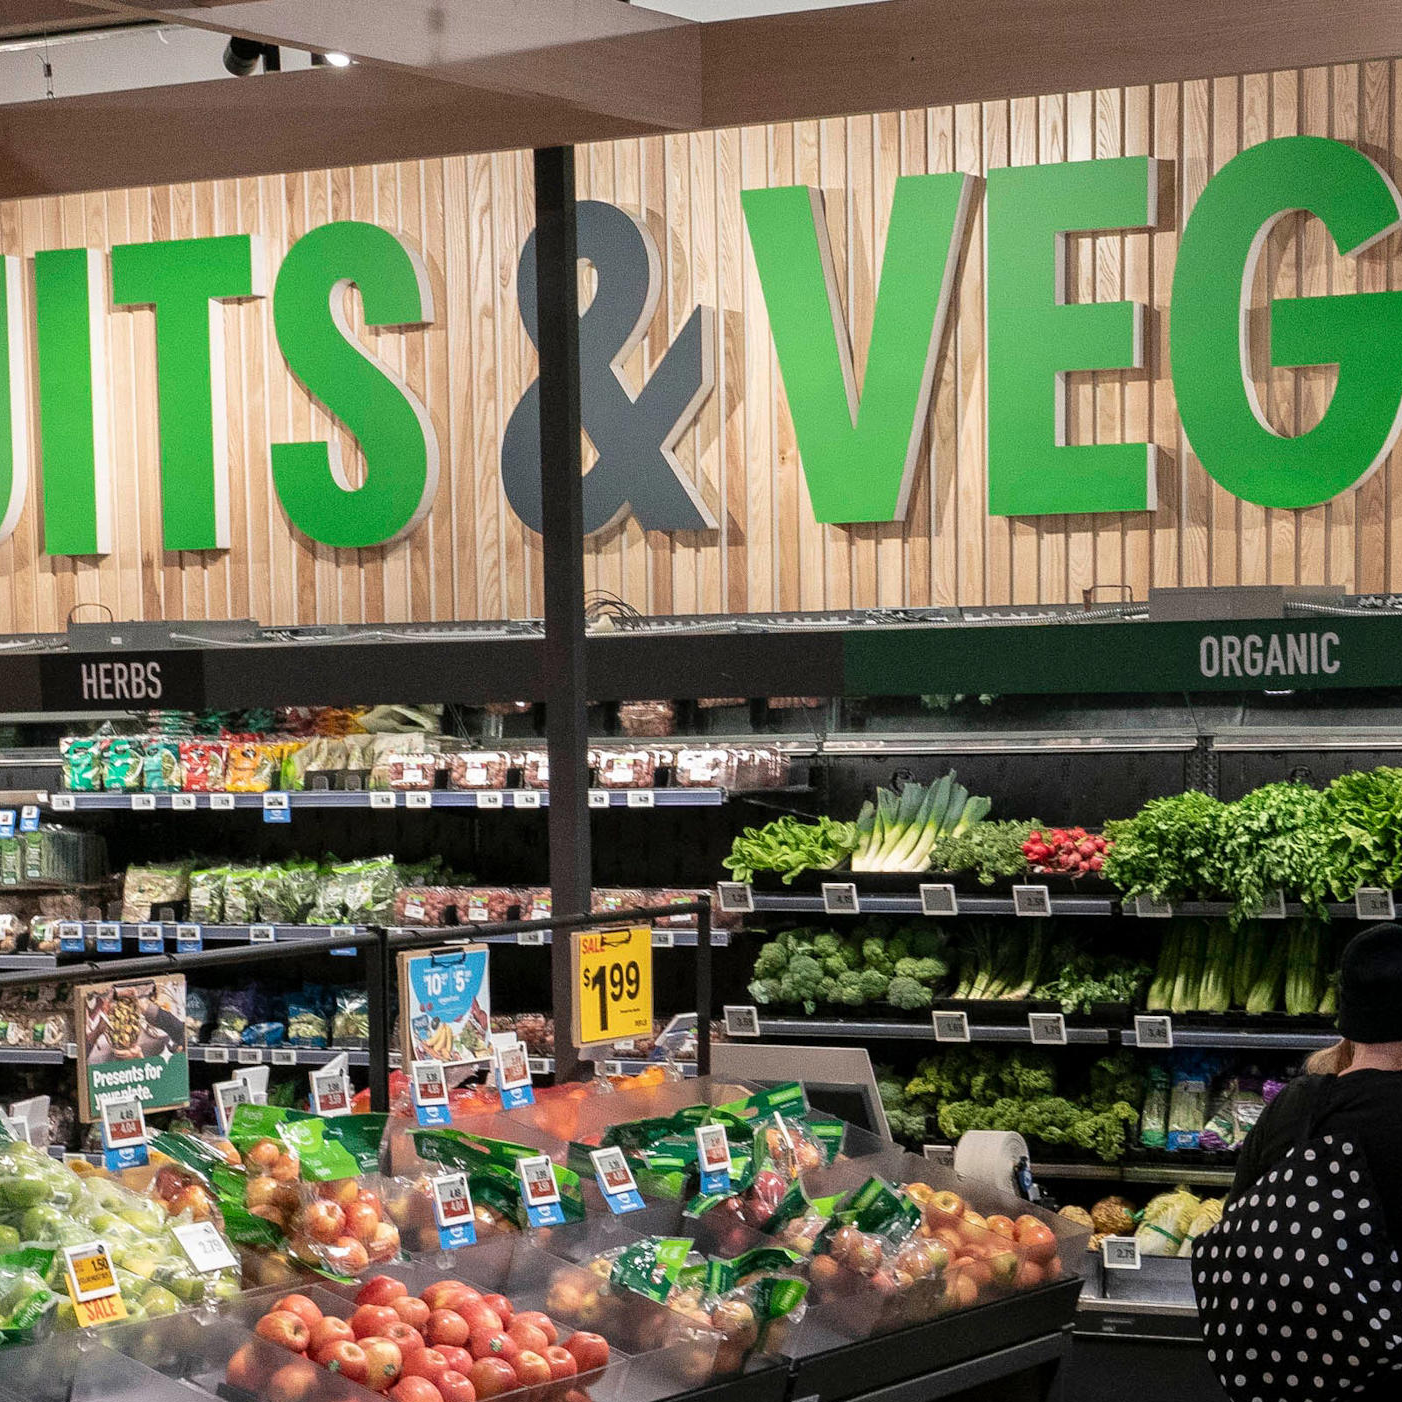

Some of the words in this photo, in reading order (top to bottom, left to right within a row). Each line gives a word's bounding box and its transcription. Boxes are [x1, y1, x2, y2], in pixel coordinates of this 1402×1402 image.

[501, 199, 718, 538] &
[1199, 631, 1342, 678] ORGANIC
[81, 661, 163, 700] HERBS
[93, 1066, 143, 1089] Presents
[144, 1063, 164, 1082] for
[83, 1297, 118, 1321] SALE
